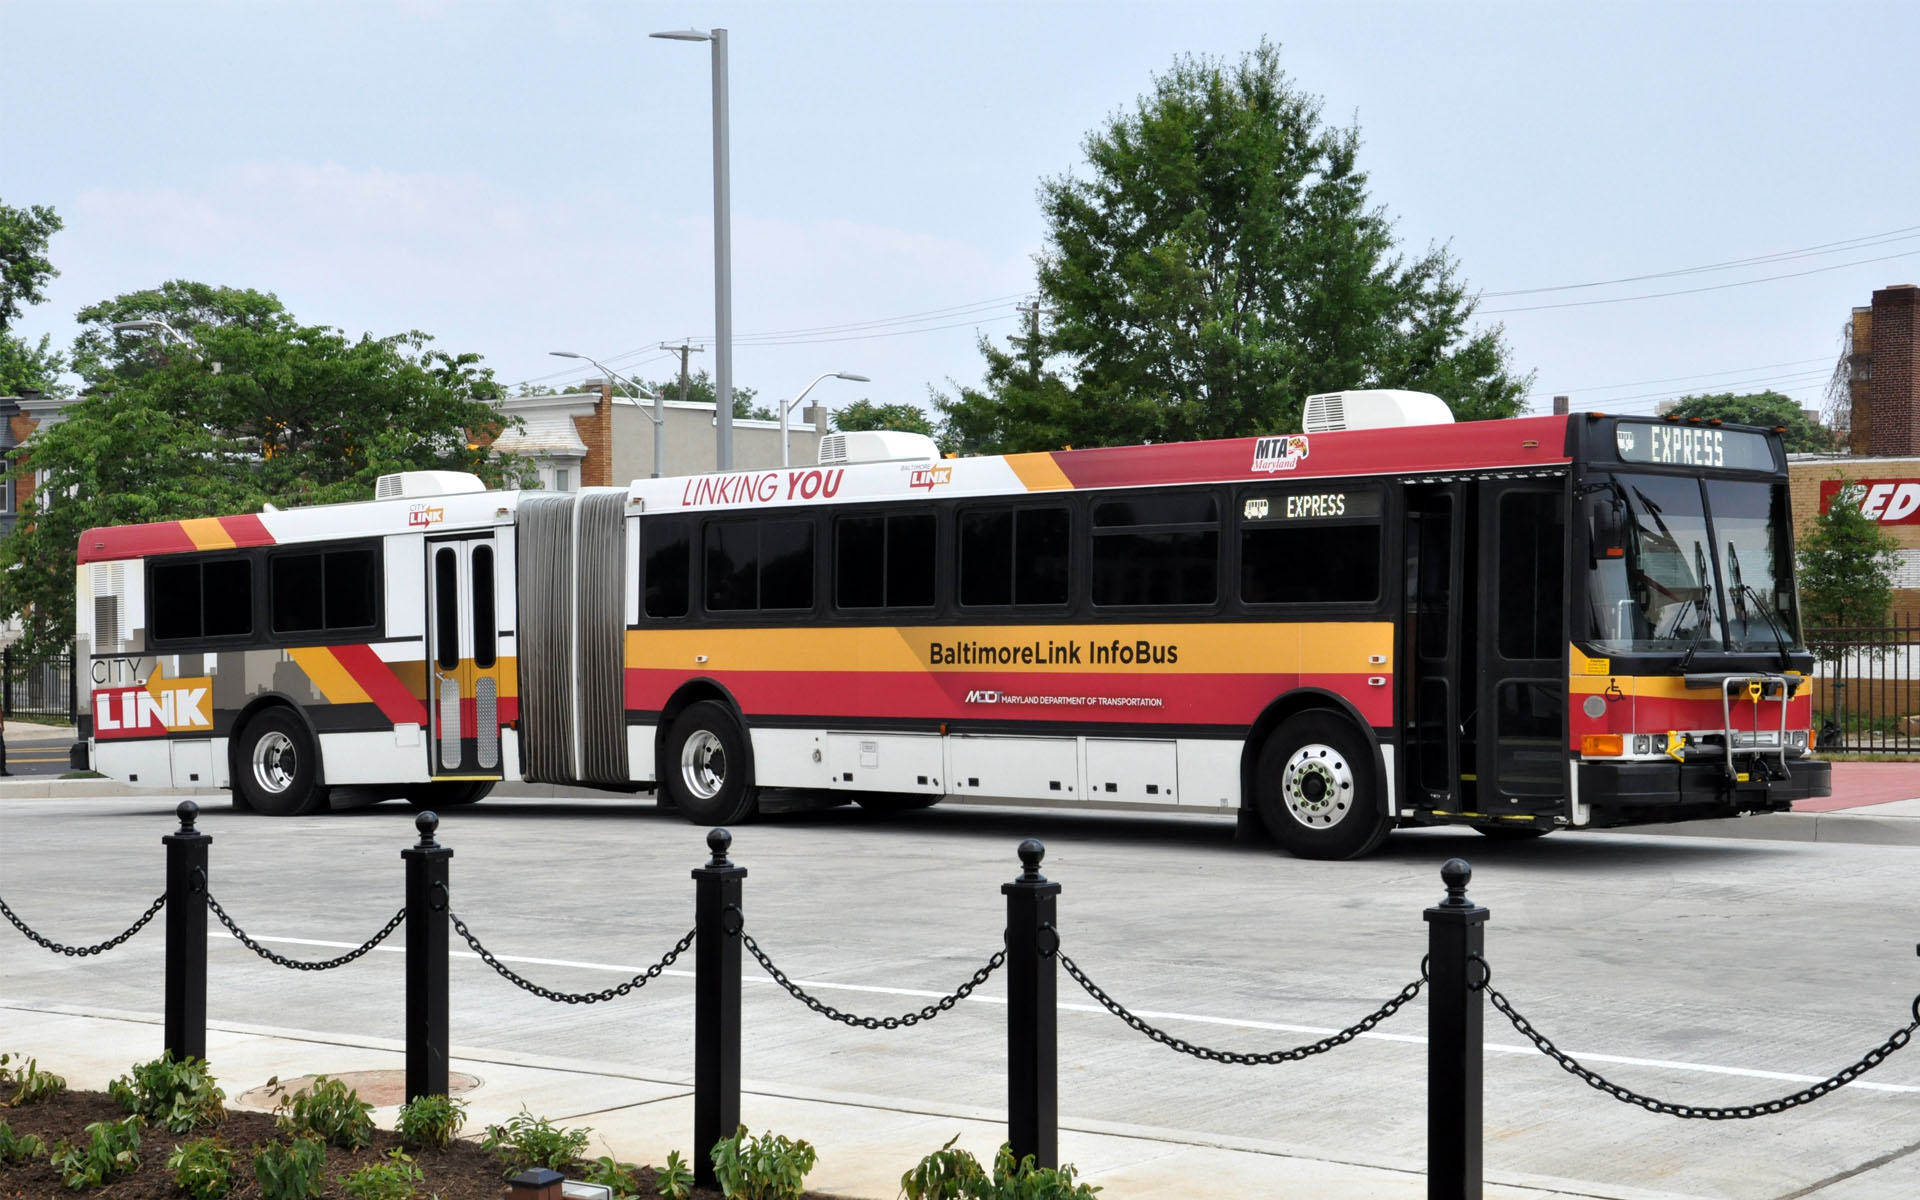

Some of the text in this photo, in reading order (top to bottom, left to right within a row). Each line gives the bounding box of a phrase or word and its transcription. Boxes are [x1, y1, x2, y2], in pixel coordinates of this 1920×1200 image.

[1256, 438, 1288, 459] MTA
[1651, 426, 1724, 467] EXPRESS
[911, 470, 950, 484] LINK
[1254, 459, 1296, 471] Maryland
[682, 469, 844, 506] LINKING YOU
[410, 511, 442, 523] LINK
[1287, 494, 1345, 518] EXPRESS
[930, 640, 1178, 664] BaltimoreLink InfoBus
[92, 658, 141, 684] CITY
[96, 688, 210, 730] LINK
[1001, 695, 1162, 707] MARYLAND DEPARTMENT OF TRANSPORTATION
